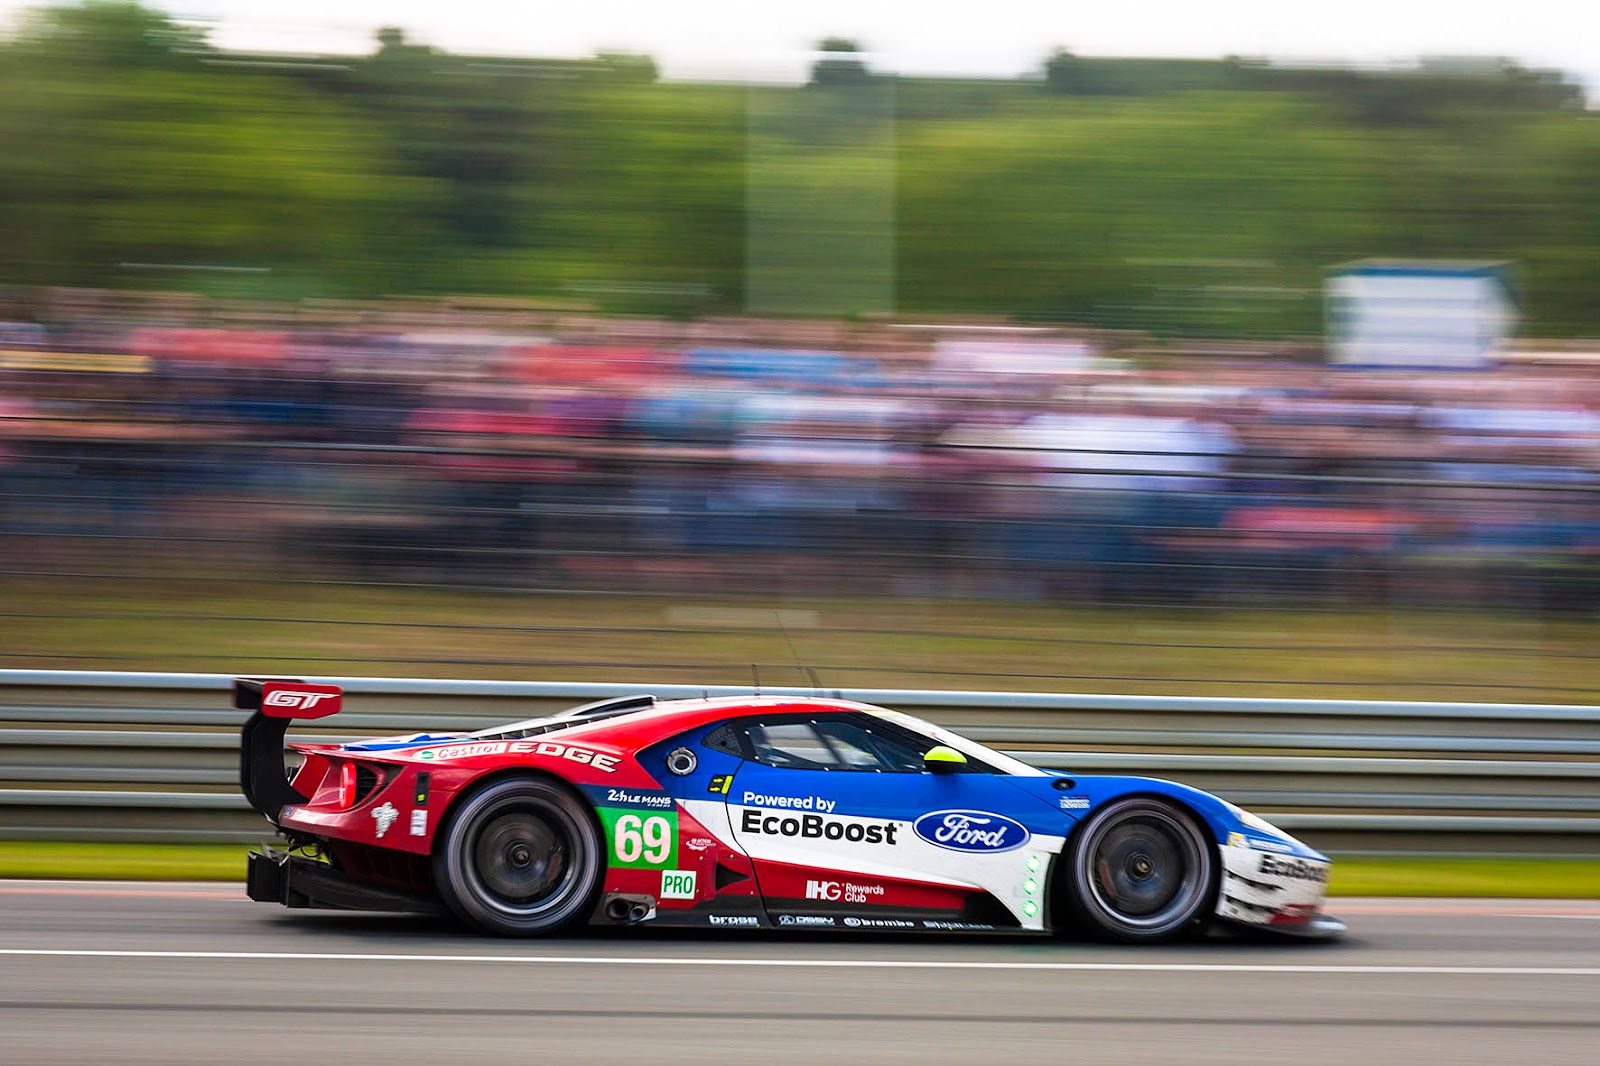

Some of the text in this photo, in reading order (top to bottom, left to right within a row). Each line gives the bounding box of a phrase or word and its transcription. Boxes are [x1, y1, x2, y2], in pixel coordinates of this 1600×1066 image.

[263, 690, 340, 710] GT
[438, 742, 622, 773] Castrol EDGE
[628, 795, 641, 803] LE
[641, 796, 671, 804] MANS
[743, 791, 835, 813] Powered by
[741, 809, 898, 845] EcoBoost
[935, 814, 1007, 847] Ford
[615, 815, 671, 864] 69
[663, 876, 693, 894] PRO
[805, 880, 842, 900] IHG
[845, 883, 884, 895] Rewards
[844, 892, 867, 902] Club
[861, 918, 915, 927] brembo
